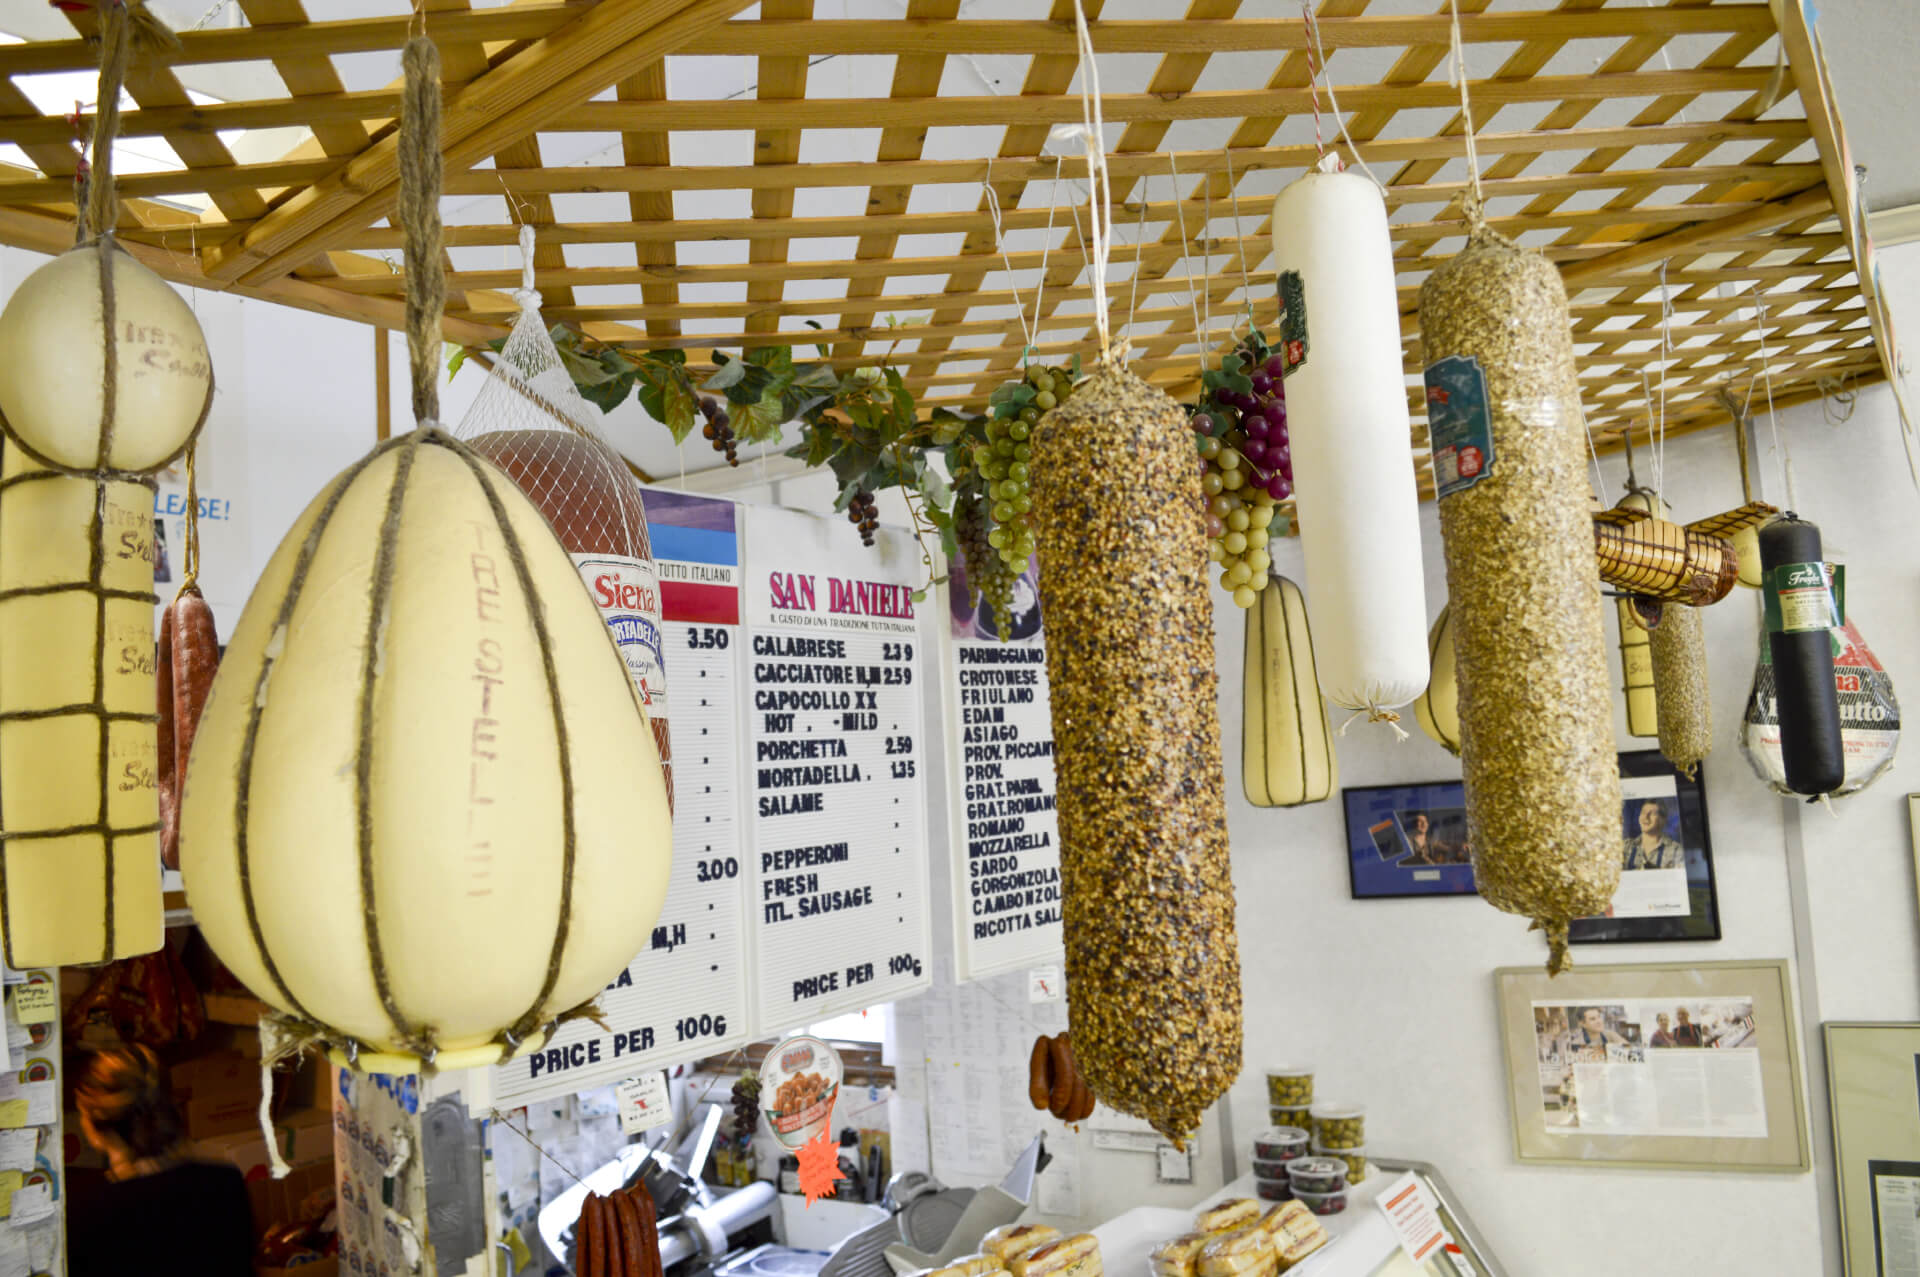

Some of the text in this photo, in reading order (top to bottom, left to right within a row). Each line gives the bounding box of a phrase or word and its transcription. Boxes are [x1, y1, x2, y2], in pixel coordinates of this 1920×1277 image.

[658, 563, 731, 583] TUTTO ITALIANO
[769, 571, 914, 619] SAN DANIELE
[779, 614, 803, 625] GUSTO
[804, 616, 812, 625] DI
[813, 617, 827, 627] UNA
[830, 618, 869, 630] TRADIZIONE
[687, 627, 729, 650] 3.50
[753, 635, 847, 659] CALABRESE
[754, 663, 853, 685] CACCIATORE
[959, 670, 1039, 687] CROTONESE
[755, 690, 878, 711] CAPOCOLLO XX
[961, 688, 1034, 706] FRIULANO
[764, 713, 795, 733] HOT
[963, 707, 1005, 725] EDAM
[963, 725, 1018, 744] ASIAGO
[757, 739, 848, 762] PORCHETTA
[964, 744, 1003, 763] PROV.
[758, 763, 861, 789] MORTADELLA
[964, 763, 1004, 782] PROV.
[758, 793, 823, 817] SALAME
[968, 817, 1025, 839] ROMANO
[968, 832, 1050, 859] MOZZARELLA
[761, 842, 849, 873] PEPPERONI
[970, 855, 1018, 878] SARDO
[697, 857, 738, 882] 3.00
[763, 873, 818, 901] FRESH
[971, 867, 1058, 897] GORGONZOLA
[798, 885, 873, 917] SAUSAGE
[974, 913, 1032, 939] RICOTTA
[793, 953, 922, 1002] PRICE PER 100G
[529, 1013, 727, 1078] PRICE PER 100G
